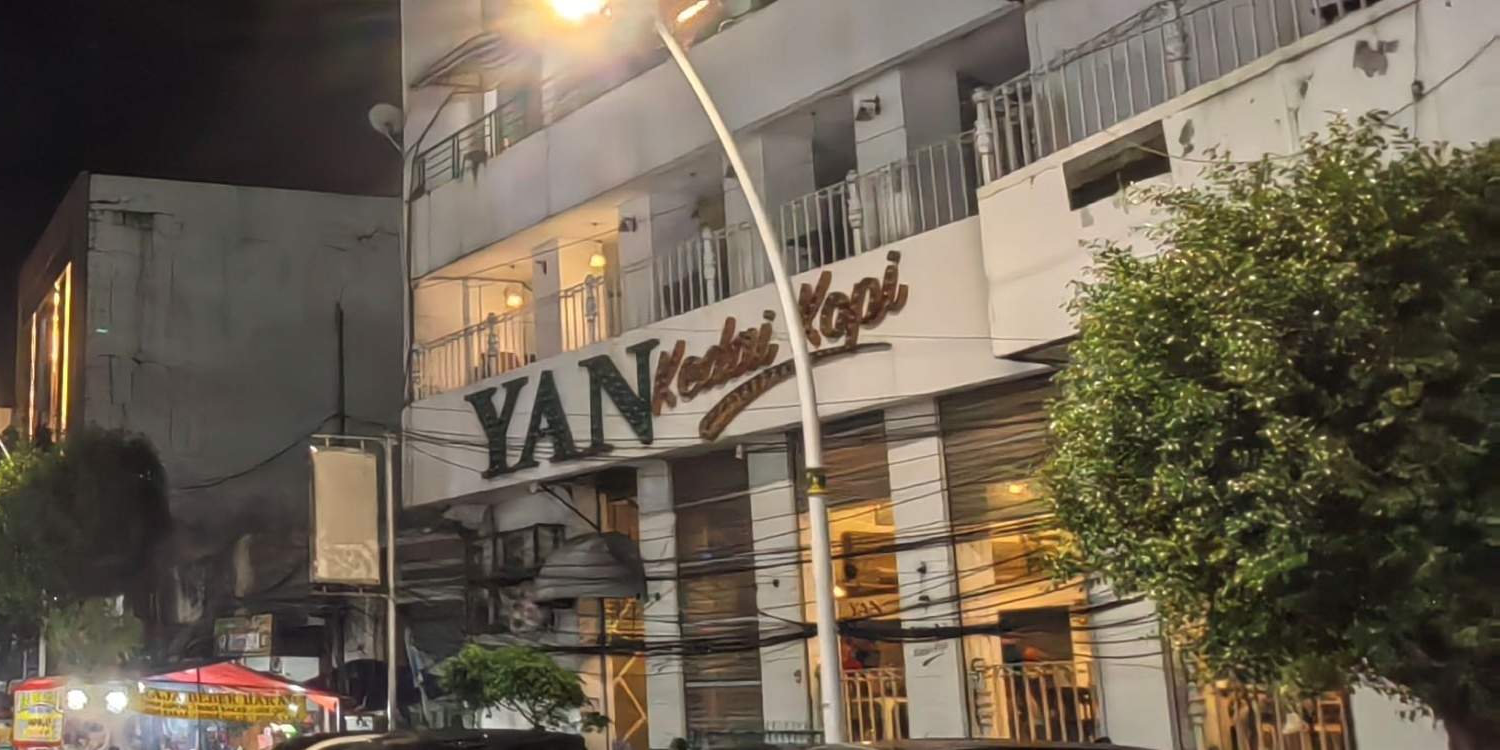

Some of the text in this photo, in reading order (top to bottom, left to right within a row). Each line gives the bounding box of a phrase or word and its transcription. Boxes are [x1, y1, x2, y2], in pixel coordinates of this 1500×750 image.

[465, 250, 908, 479] YAN Kedai Kopi
